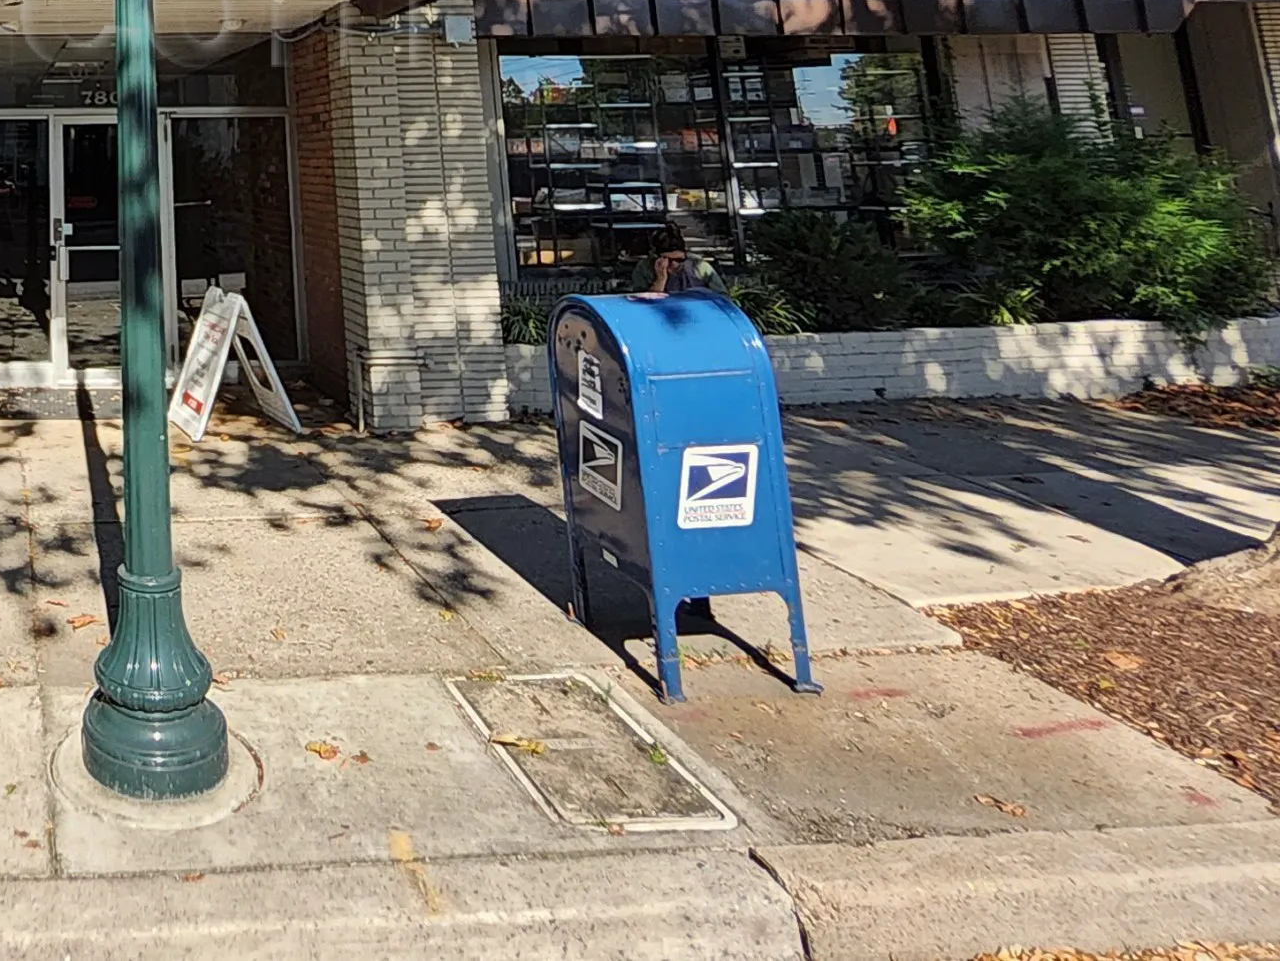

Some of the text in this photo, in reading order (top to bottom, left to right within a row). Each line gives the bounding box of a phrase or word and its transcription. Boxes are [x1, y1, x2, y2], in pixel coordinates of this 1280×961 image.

[683, 505, 715, 515] UNITED
[683, 512, 746, 523] POSTAL SERVICE
